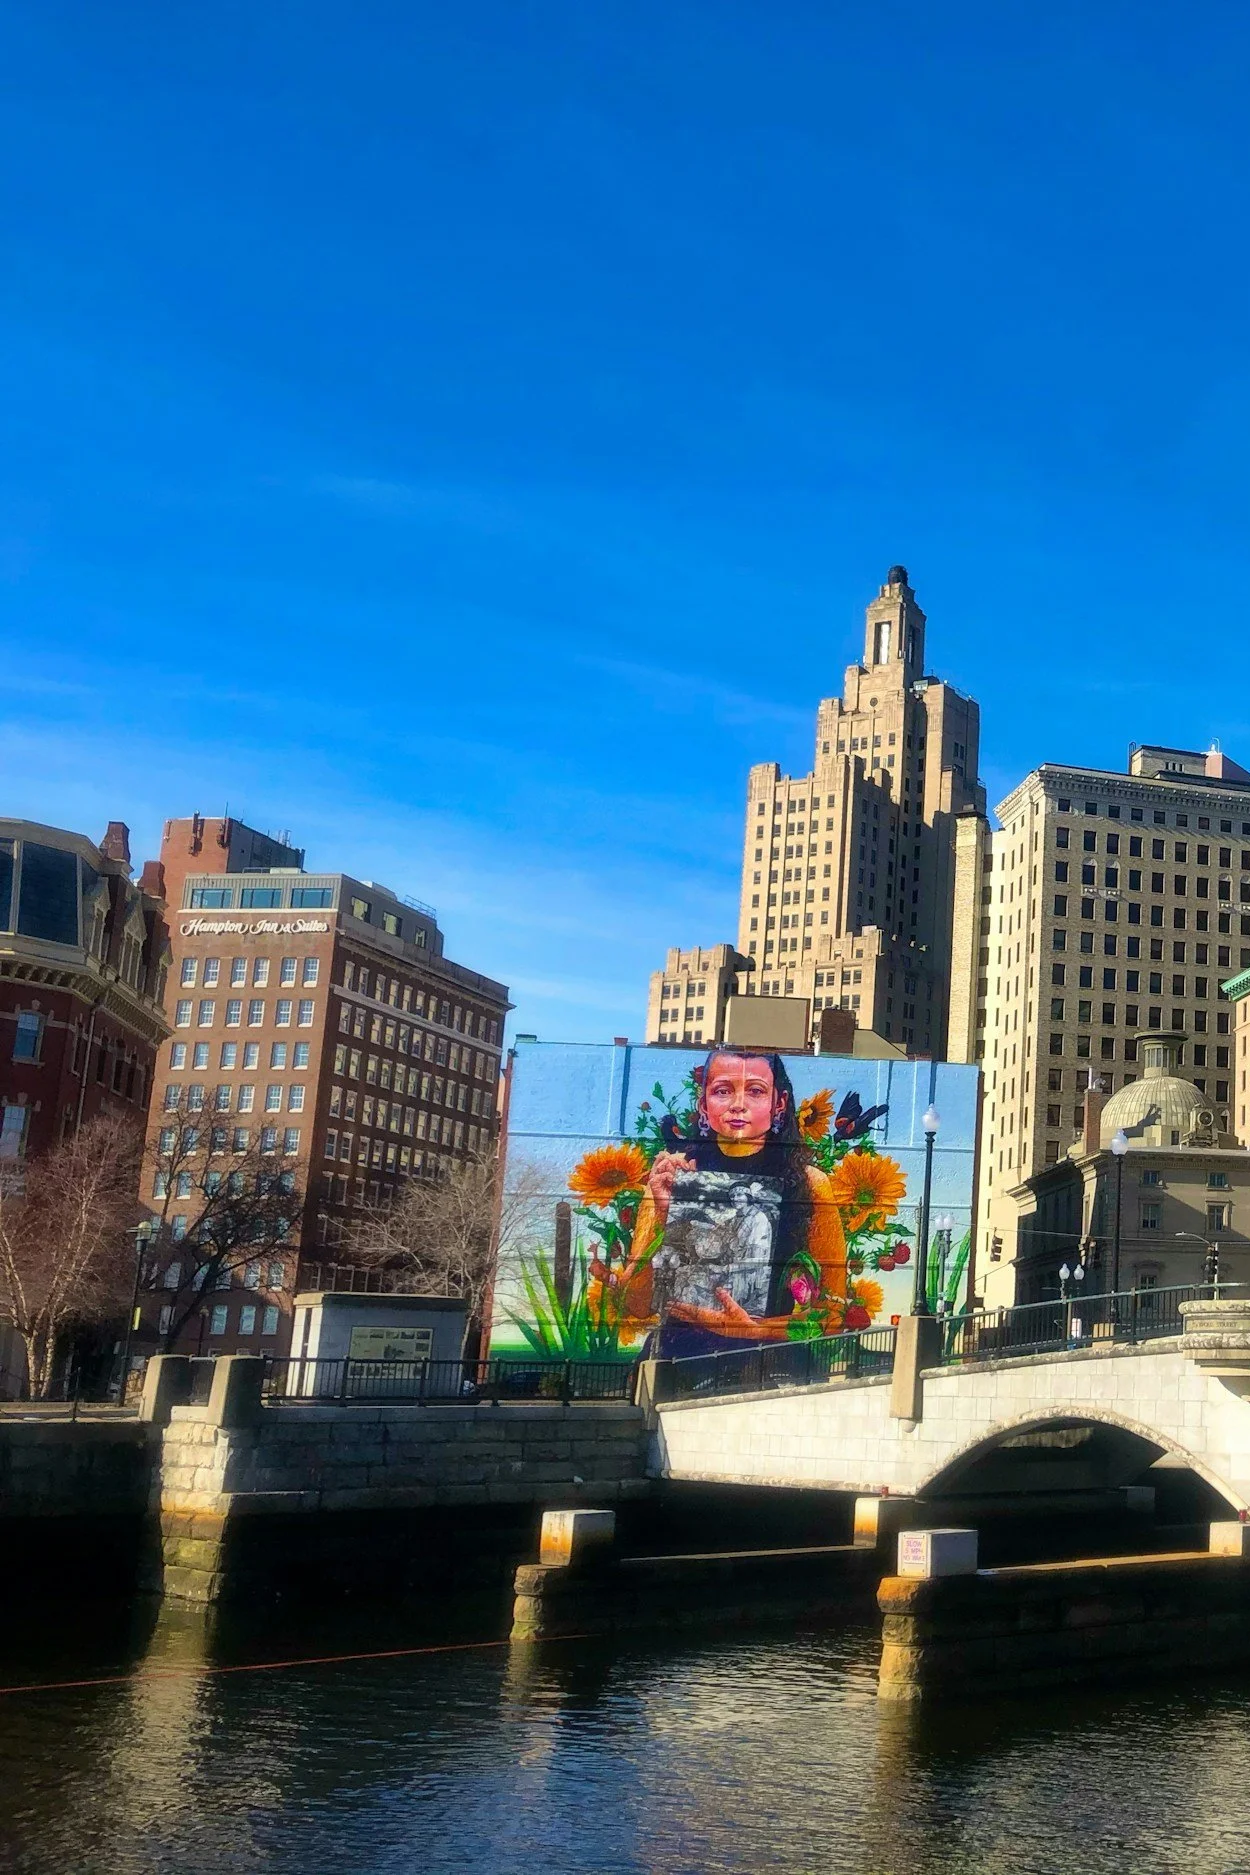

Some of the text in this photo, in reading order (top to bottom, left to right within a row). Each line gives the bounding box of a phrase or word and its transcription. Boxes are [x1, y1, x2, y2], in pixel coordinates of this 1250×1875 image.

[181, 918, 328, 935] Hampton Inn & Suites
